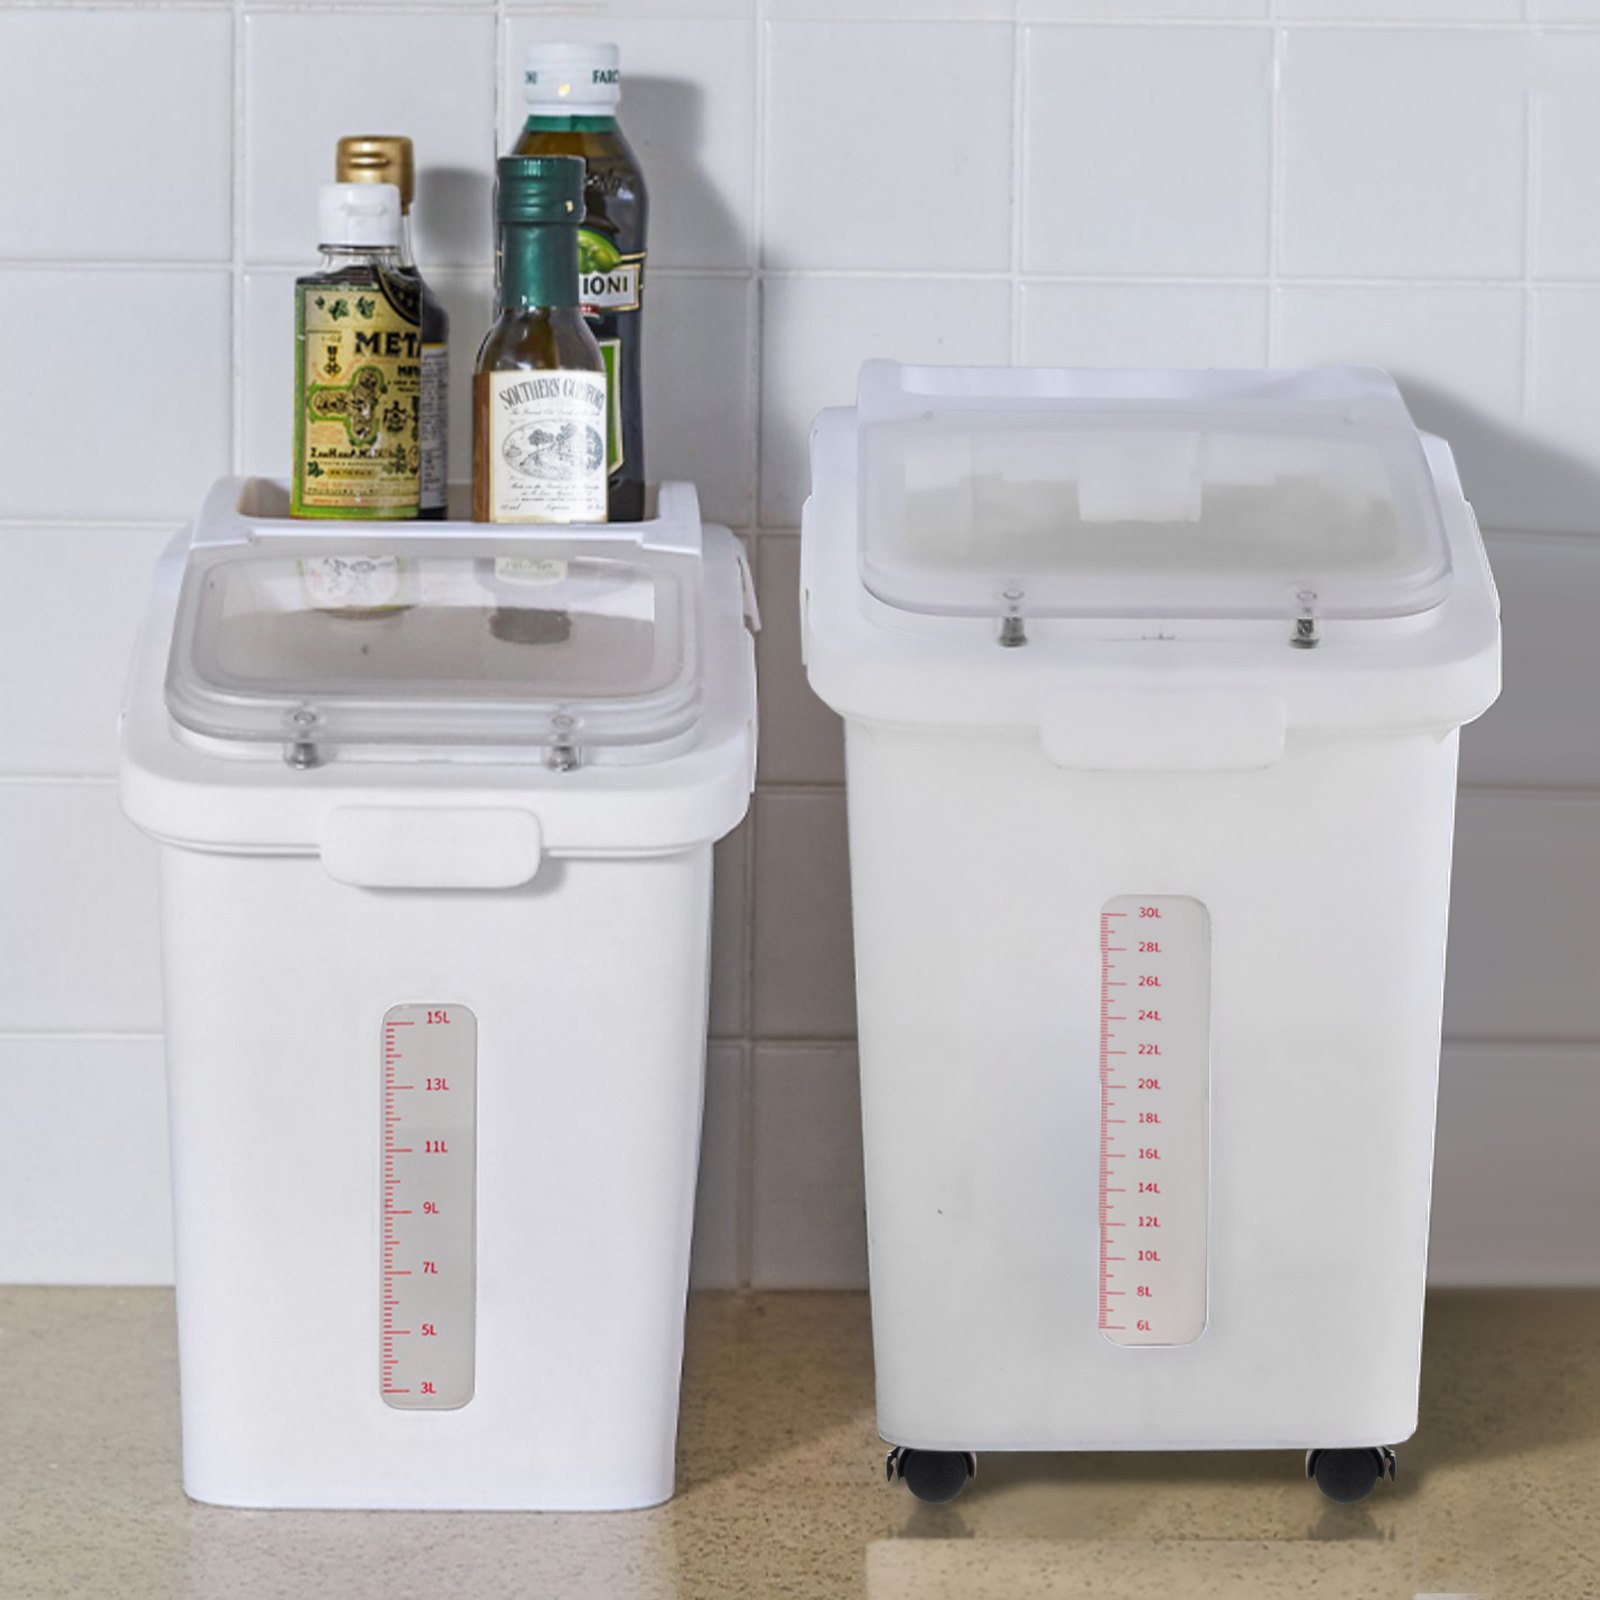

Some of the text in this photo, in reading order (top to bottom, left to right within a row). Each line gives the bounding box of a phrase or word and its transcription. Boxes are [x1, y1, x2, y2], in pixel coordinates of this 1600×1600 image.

[499, 377, 560, 410] SOUTHERN
[1139, 907, 1160, 919] 30L
[1138, 942, 1160, 953] 28L
[1138, 976, 1161, 988] 26L
[426, 1010, 450, 1025] 15L
[1138, 1010, 1161, 1022] 24L
[1138, 1044, 1161, 1056] 22L
[425, 1077, 449, 1092] 13L
[1138, 1078, 1161, 1090] 20L
[1138, 1113, 1161, 1125] 18L
[425, 1139, 448, 1154] 11L
[1138, 1148, 1161, 1160] 16L
[1138, 1182, 1161, 1194] 14L
[423, 1200, 439, 1215] 9L
[1138, 1216, 1161, 1228] 12L
[1138, 1250, 1161, 1262] 10L
[423, 1260, 438, 1275] 7L
[1137, 1285, 1152, 1297] 8L
[421, 1322, 437, 1338] 5L
[1137, 1319, 1152, 1332] 6L
[421, 1380, 436, 1395] 3L
